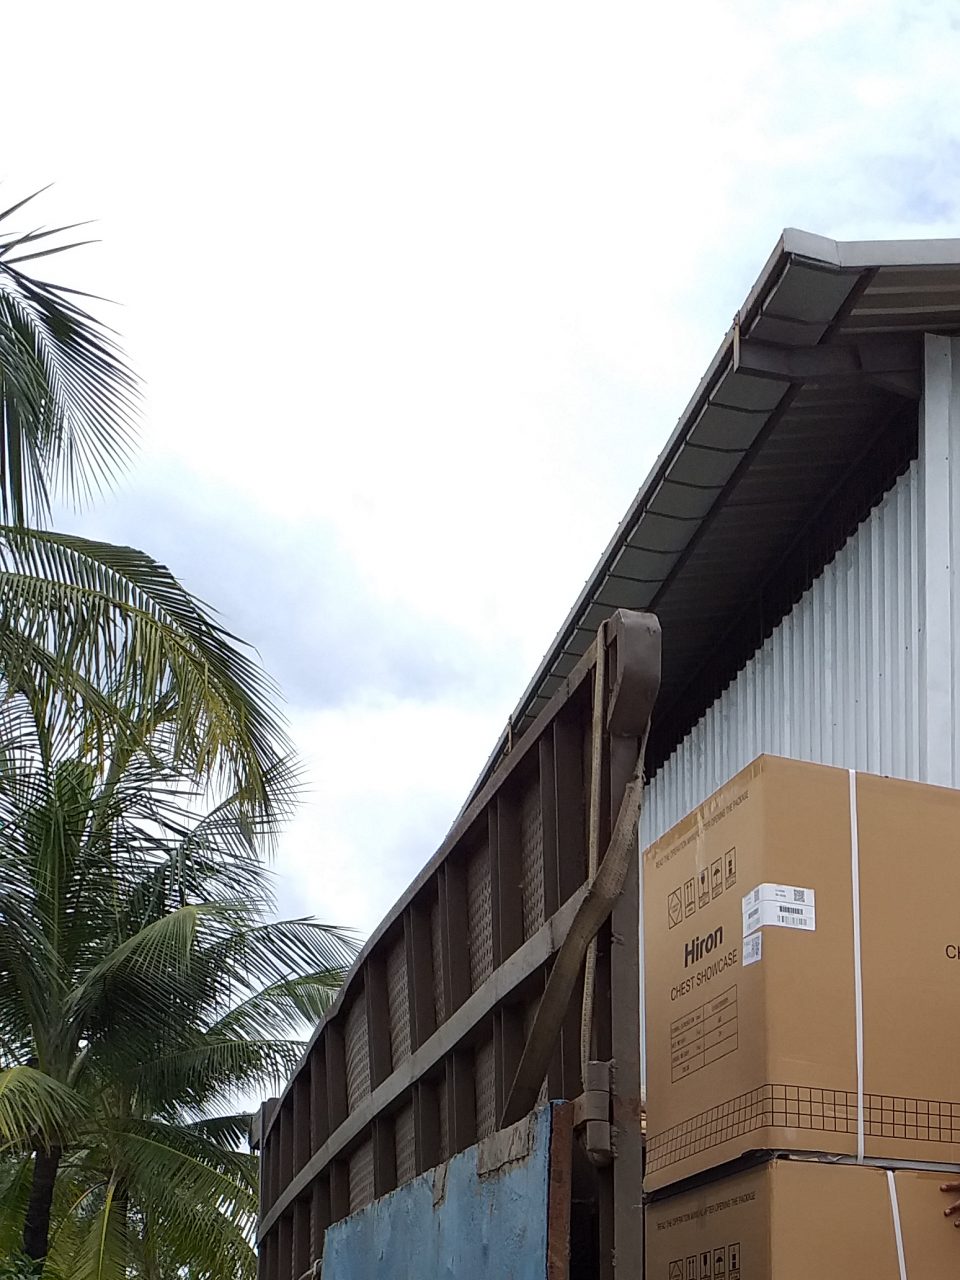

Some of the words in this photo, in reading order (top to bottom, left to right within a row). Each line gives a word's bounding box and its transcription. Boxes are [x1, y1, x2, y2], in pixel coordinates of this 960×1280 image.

[684, 926, 723, 968] Hiron
[671, 975, 694, 1001] CHEST
[696, 949, 738, 987] SHOWCASE
